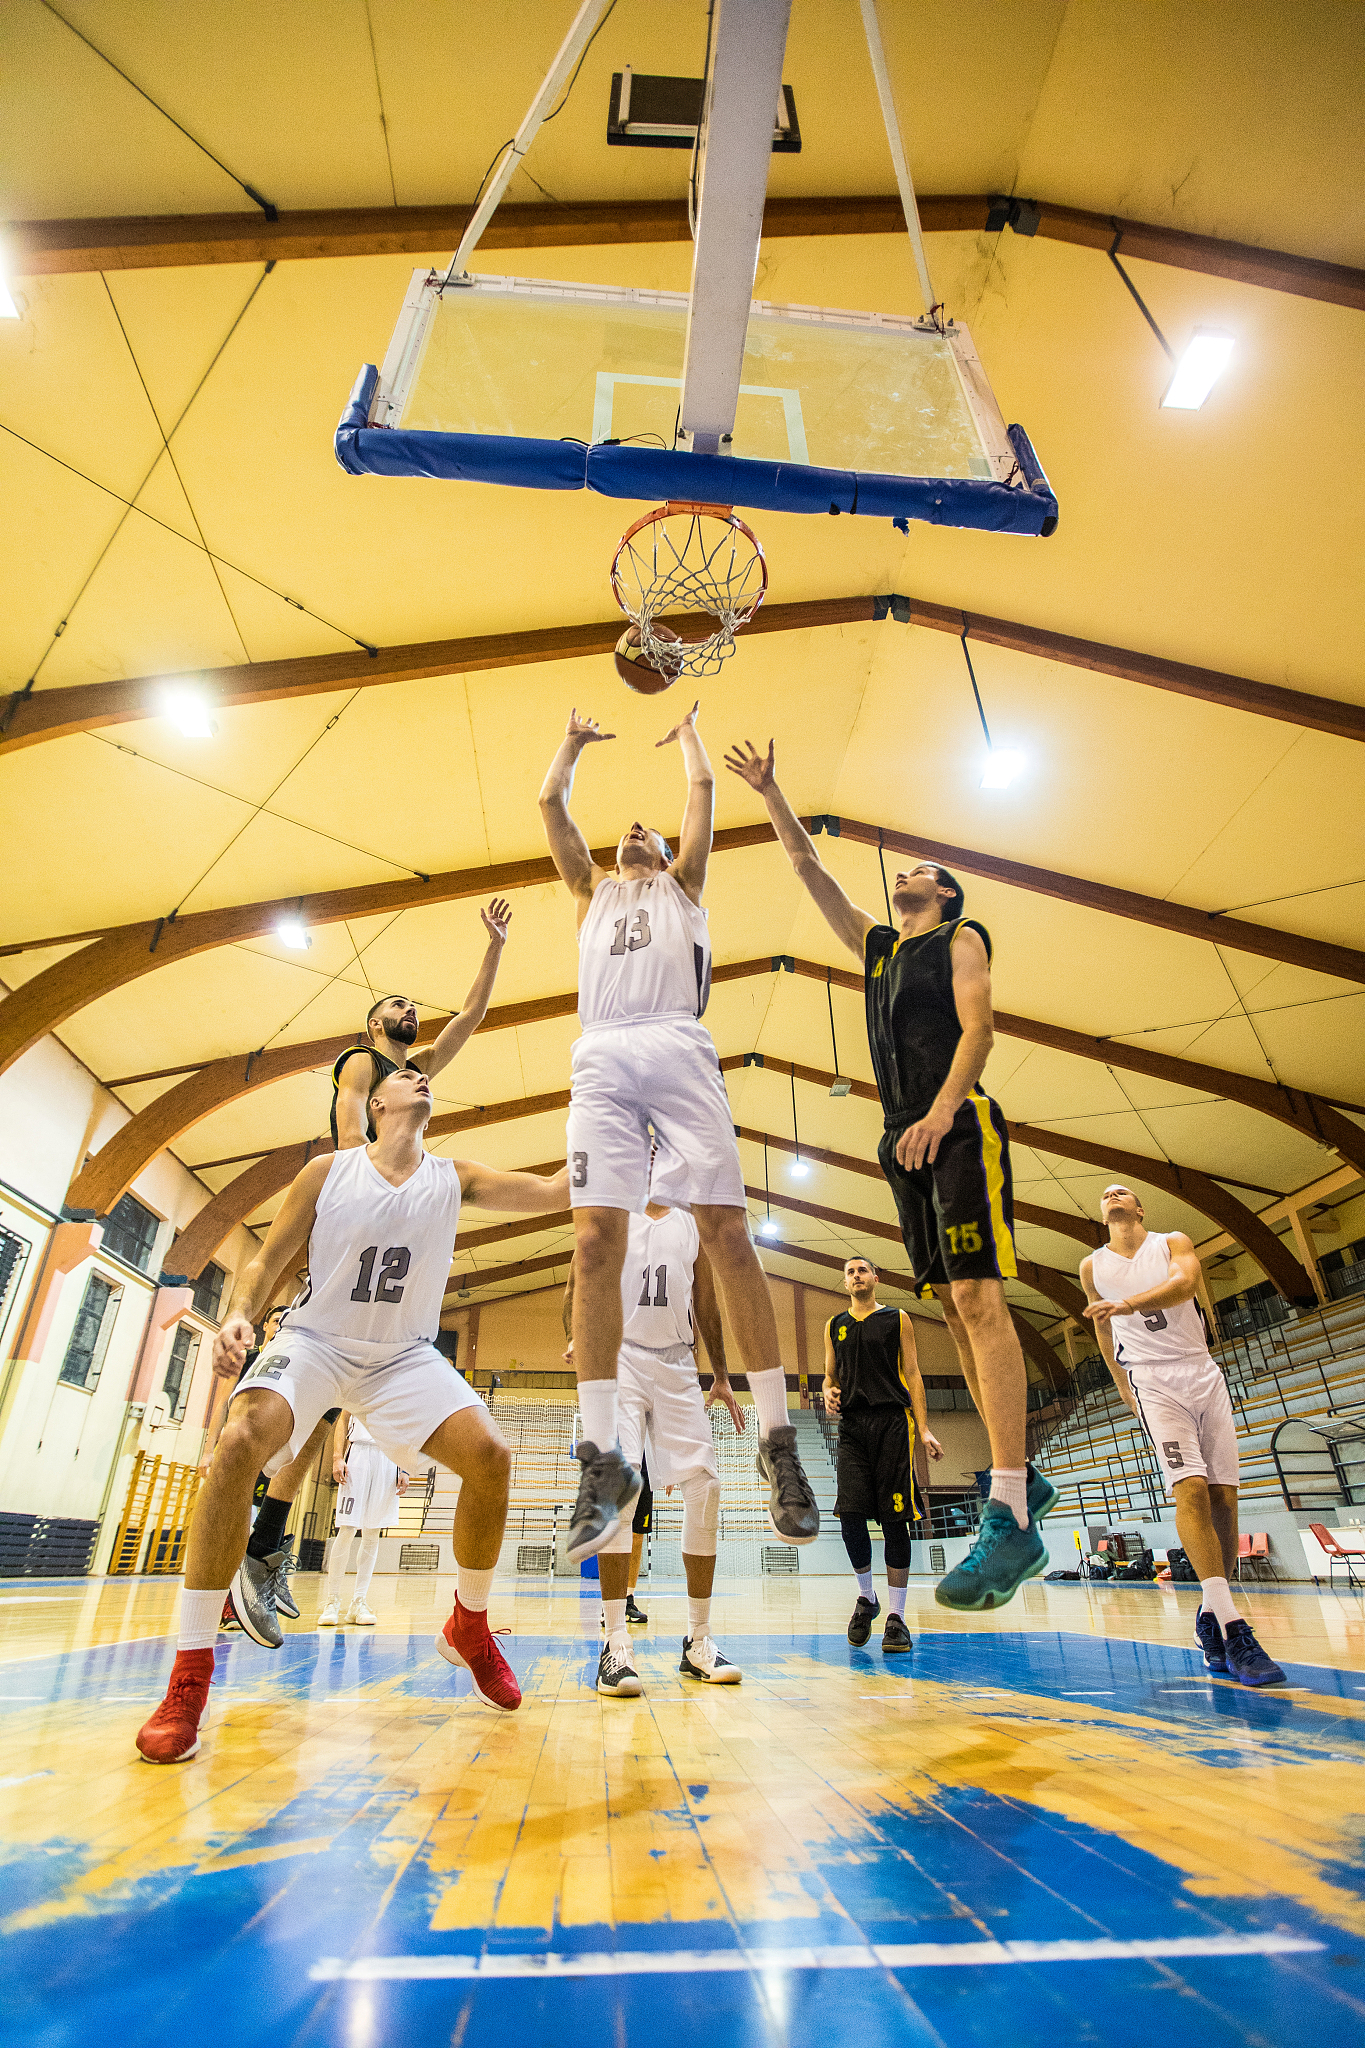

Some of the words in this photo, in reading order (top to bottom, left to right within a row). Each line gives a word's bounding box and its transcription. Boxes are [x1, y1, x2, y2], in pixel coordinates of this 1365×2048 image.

[610, 908, 652, 956] 13
[945, 1221, 983, 1255] 15
[350, 1246, 412, 1304] 12
[637, 1264, 668, 1307] 11
[1161, 1441, 1185, 1469] 5
[339, 1496, 355, 1515] 10
[892, 1492, 905, 1513] 3
[642, 1513, 650, 1528] 1
